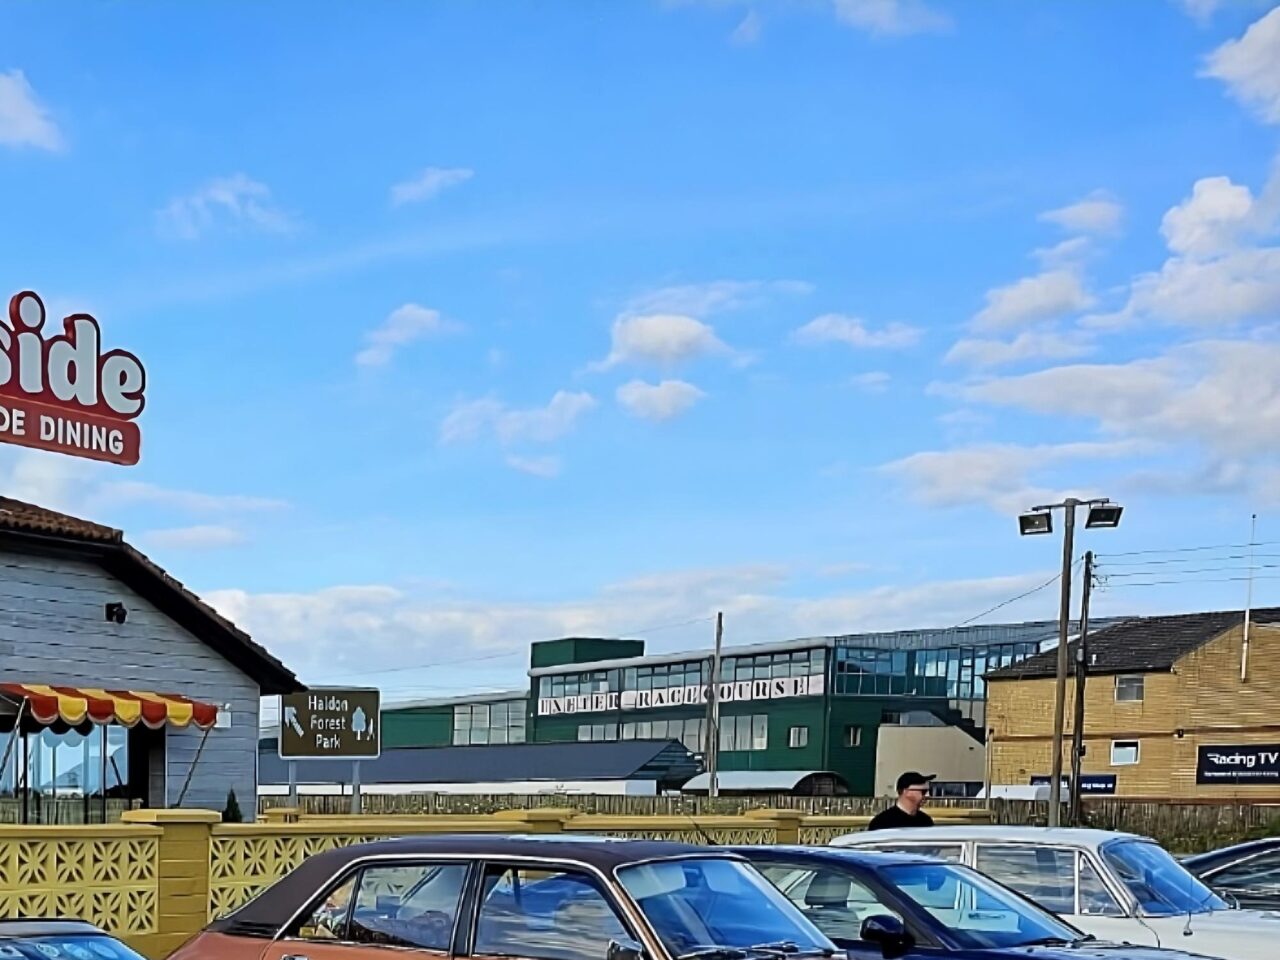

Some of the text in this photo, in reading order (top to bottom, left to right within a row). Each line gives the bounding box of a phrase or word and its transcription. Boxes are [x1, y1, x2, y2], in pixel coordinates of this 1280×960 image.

[39, 415, 124, 455] DINING
[308, 695, 348, 711] Haldon
[310, 714, 346, 730] Forest
[316, 733, 341, 749] Park
[1207, 752, 1279, 767] Racing TV
